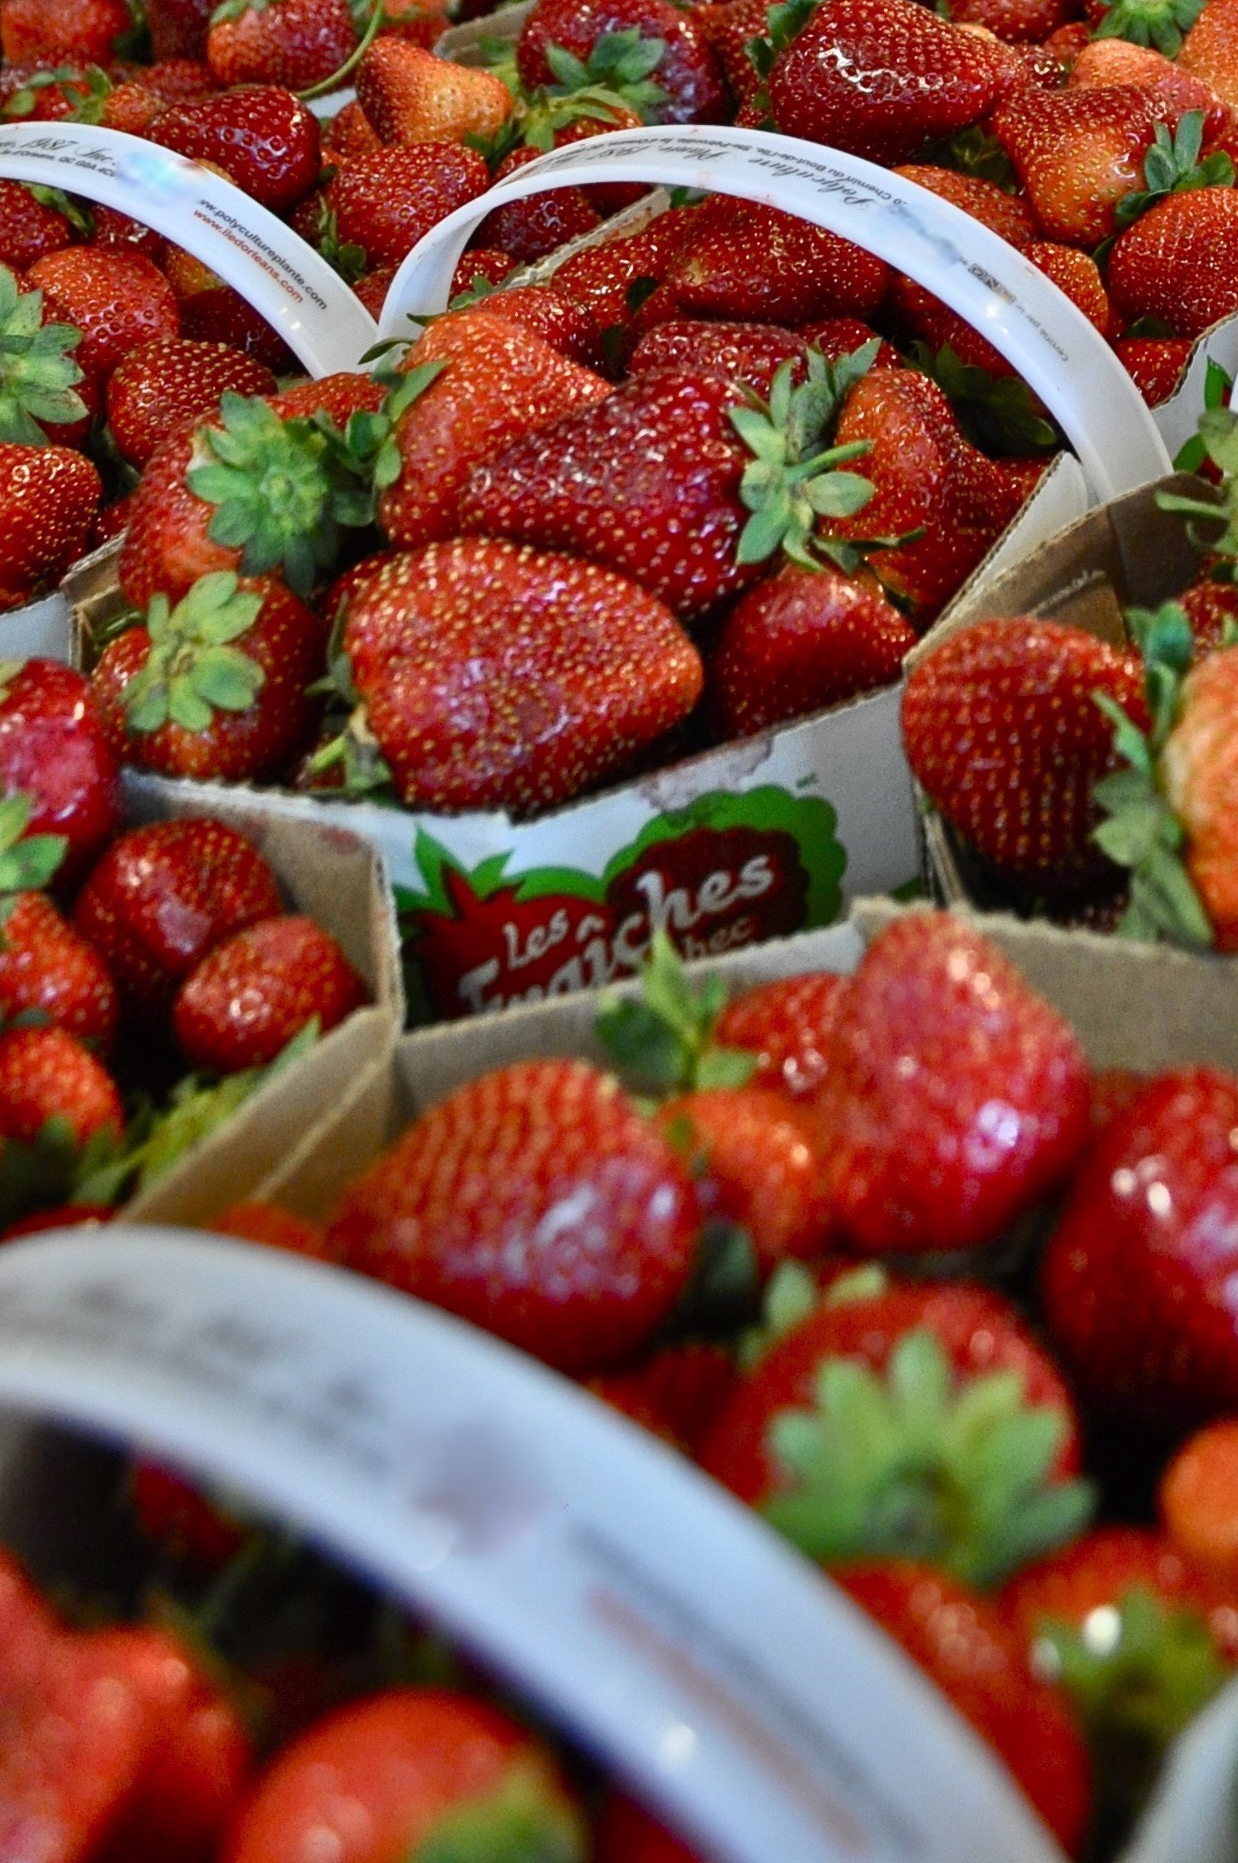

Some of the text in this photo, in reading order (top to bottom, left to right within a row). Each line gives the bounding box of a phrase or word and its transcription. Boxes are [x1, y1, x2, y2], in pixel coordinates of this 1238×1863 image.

[749, 157, 876, 211] Polyculture
[829, 167, 846, 179] du
[846, 175, 892, 201] Chemin
[502, 908, 569, 971] Les
